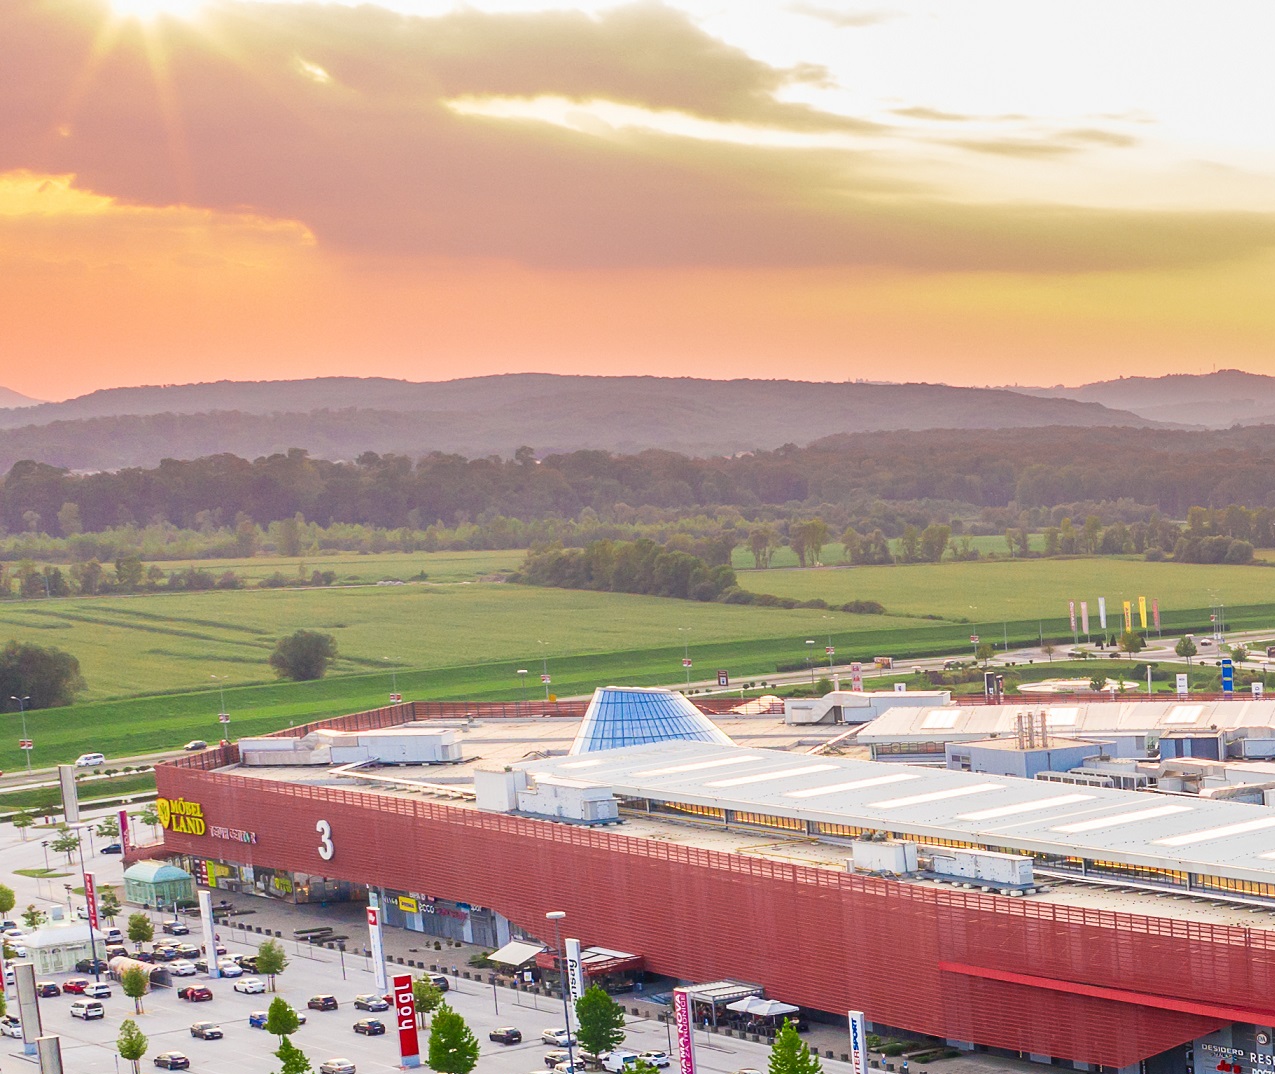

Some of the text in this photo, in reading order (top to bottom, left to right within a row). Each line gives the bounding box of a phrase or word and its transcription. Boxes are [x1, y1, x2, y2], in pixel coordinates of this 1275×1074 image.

[170, 798, 204, 818] MÖBEL
[171, 816, 206, 836] LAND
[316, 819, 335, 861] 3
[394, 982, 414, 1030] högl
[675, 993, 684, 1033] NOVA
[1201, 1043, 1244, 1056] DESIDERO
